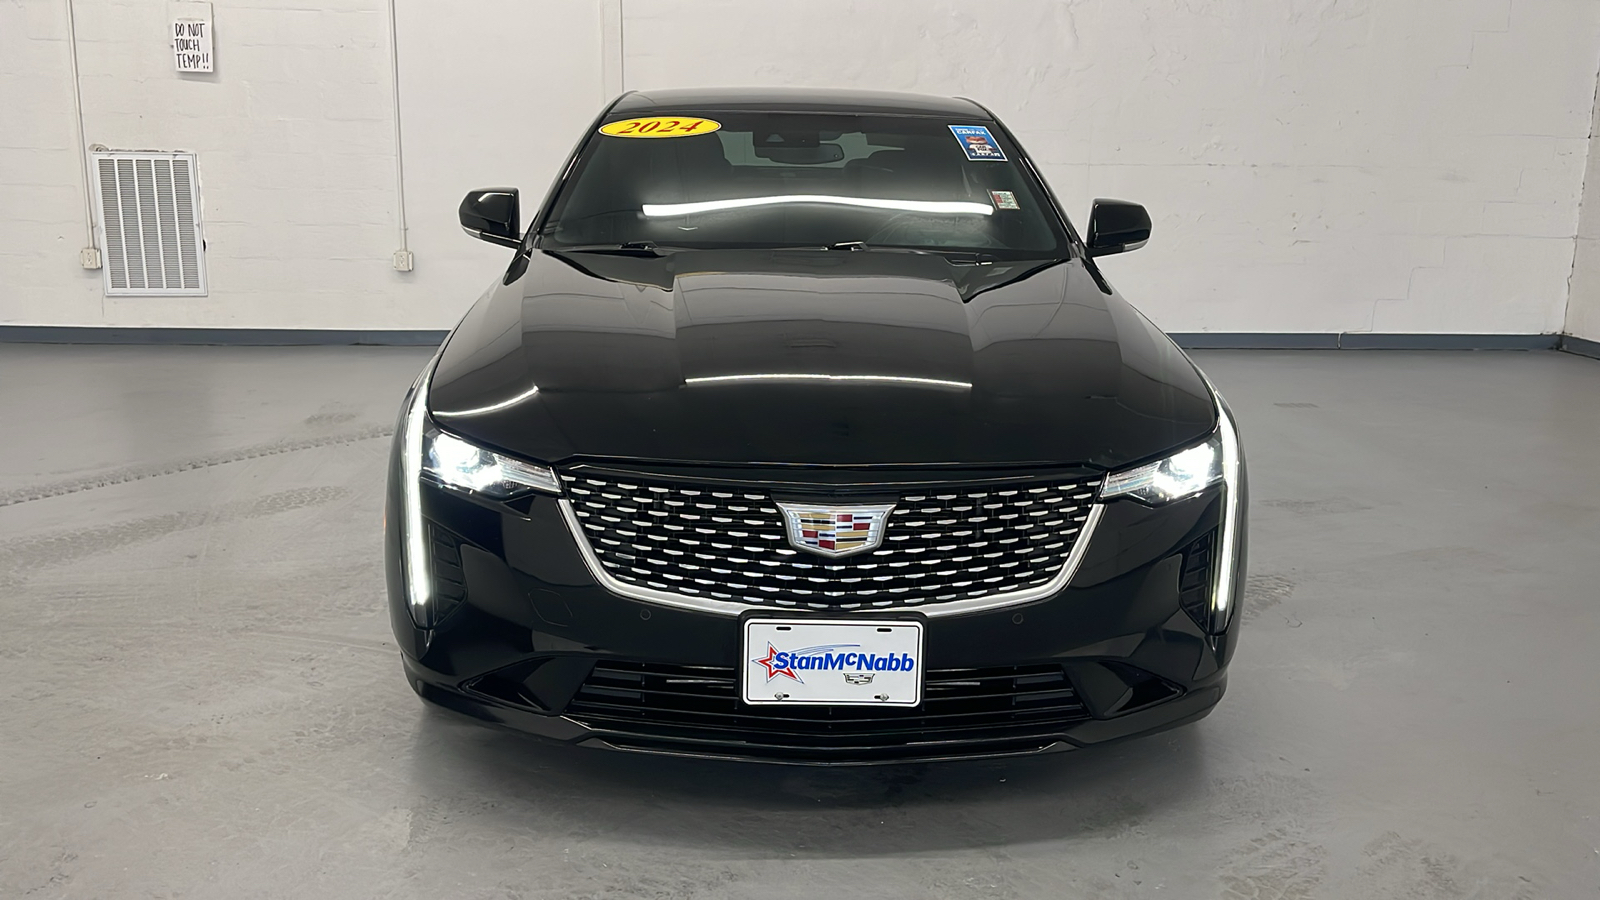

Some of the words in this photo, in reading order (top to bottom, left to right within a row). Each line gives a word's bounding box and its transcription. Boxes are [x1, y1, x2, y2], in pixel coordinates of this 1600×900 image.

[175, 23, 185, 37] DO
[187, 23, 205, 38] NOT
[174, 38, 200, 52] TOUCH
[176, 53, 209, 69] TEMP!!
[617, 120, 704, 135] 2024
